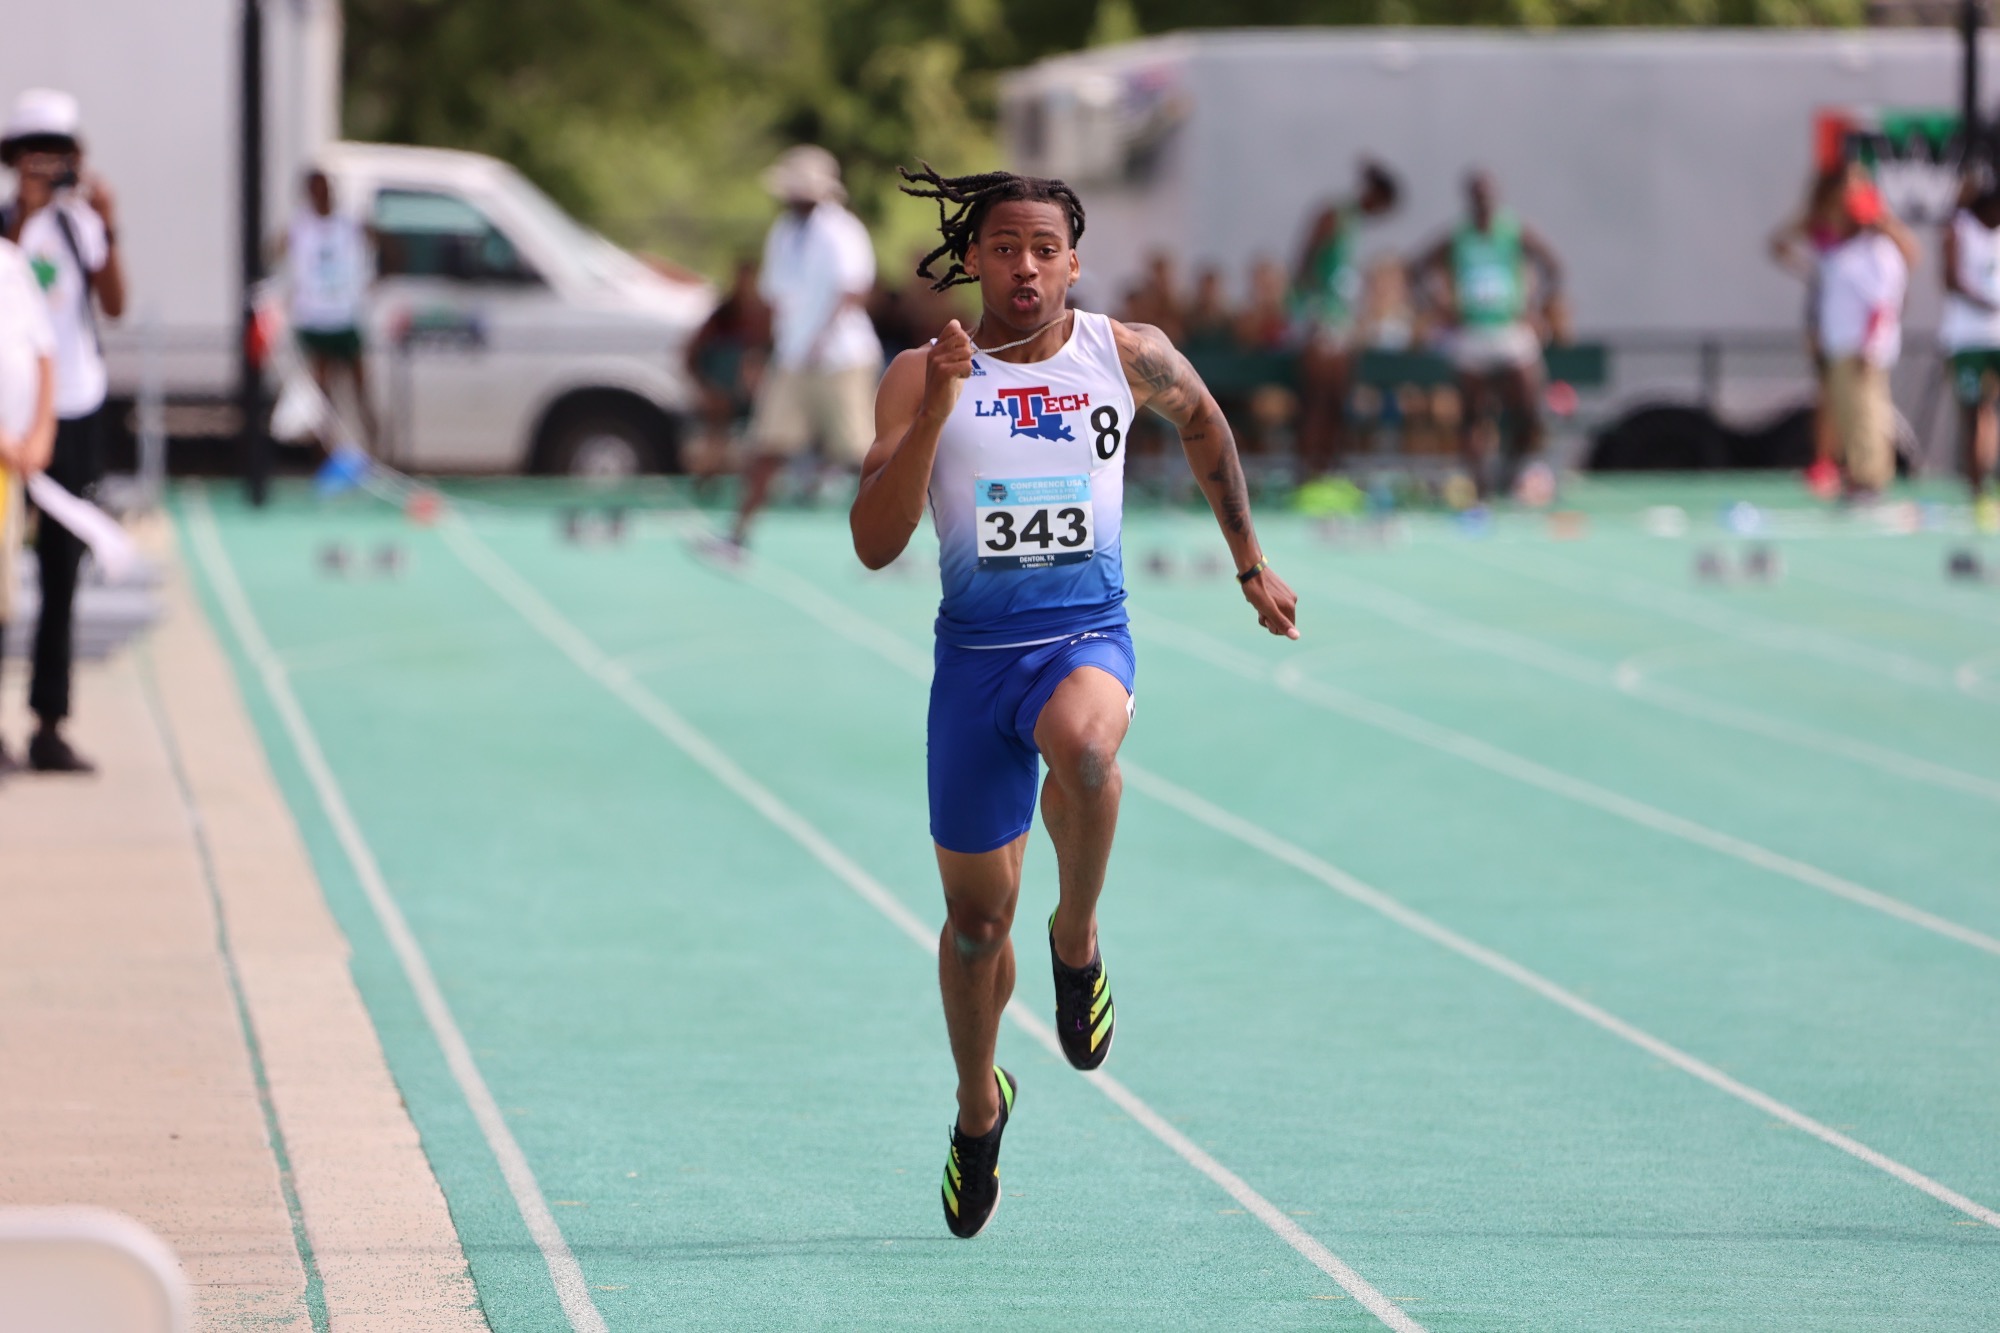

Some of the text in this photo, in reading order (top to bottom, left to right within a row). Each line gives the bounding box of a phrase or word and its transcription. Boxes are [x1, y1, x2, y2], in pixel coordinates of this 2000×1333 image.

[975, 400, 1008, 417] LA
[1090, 405, 1120, 460] 8
[1010, 479, 1083, 490] CONFERENCE USA
[1017, 493, 1077, 503] CHAMPIONSHIPS
[984, 507, 1087, 551] 343
